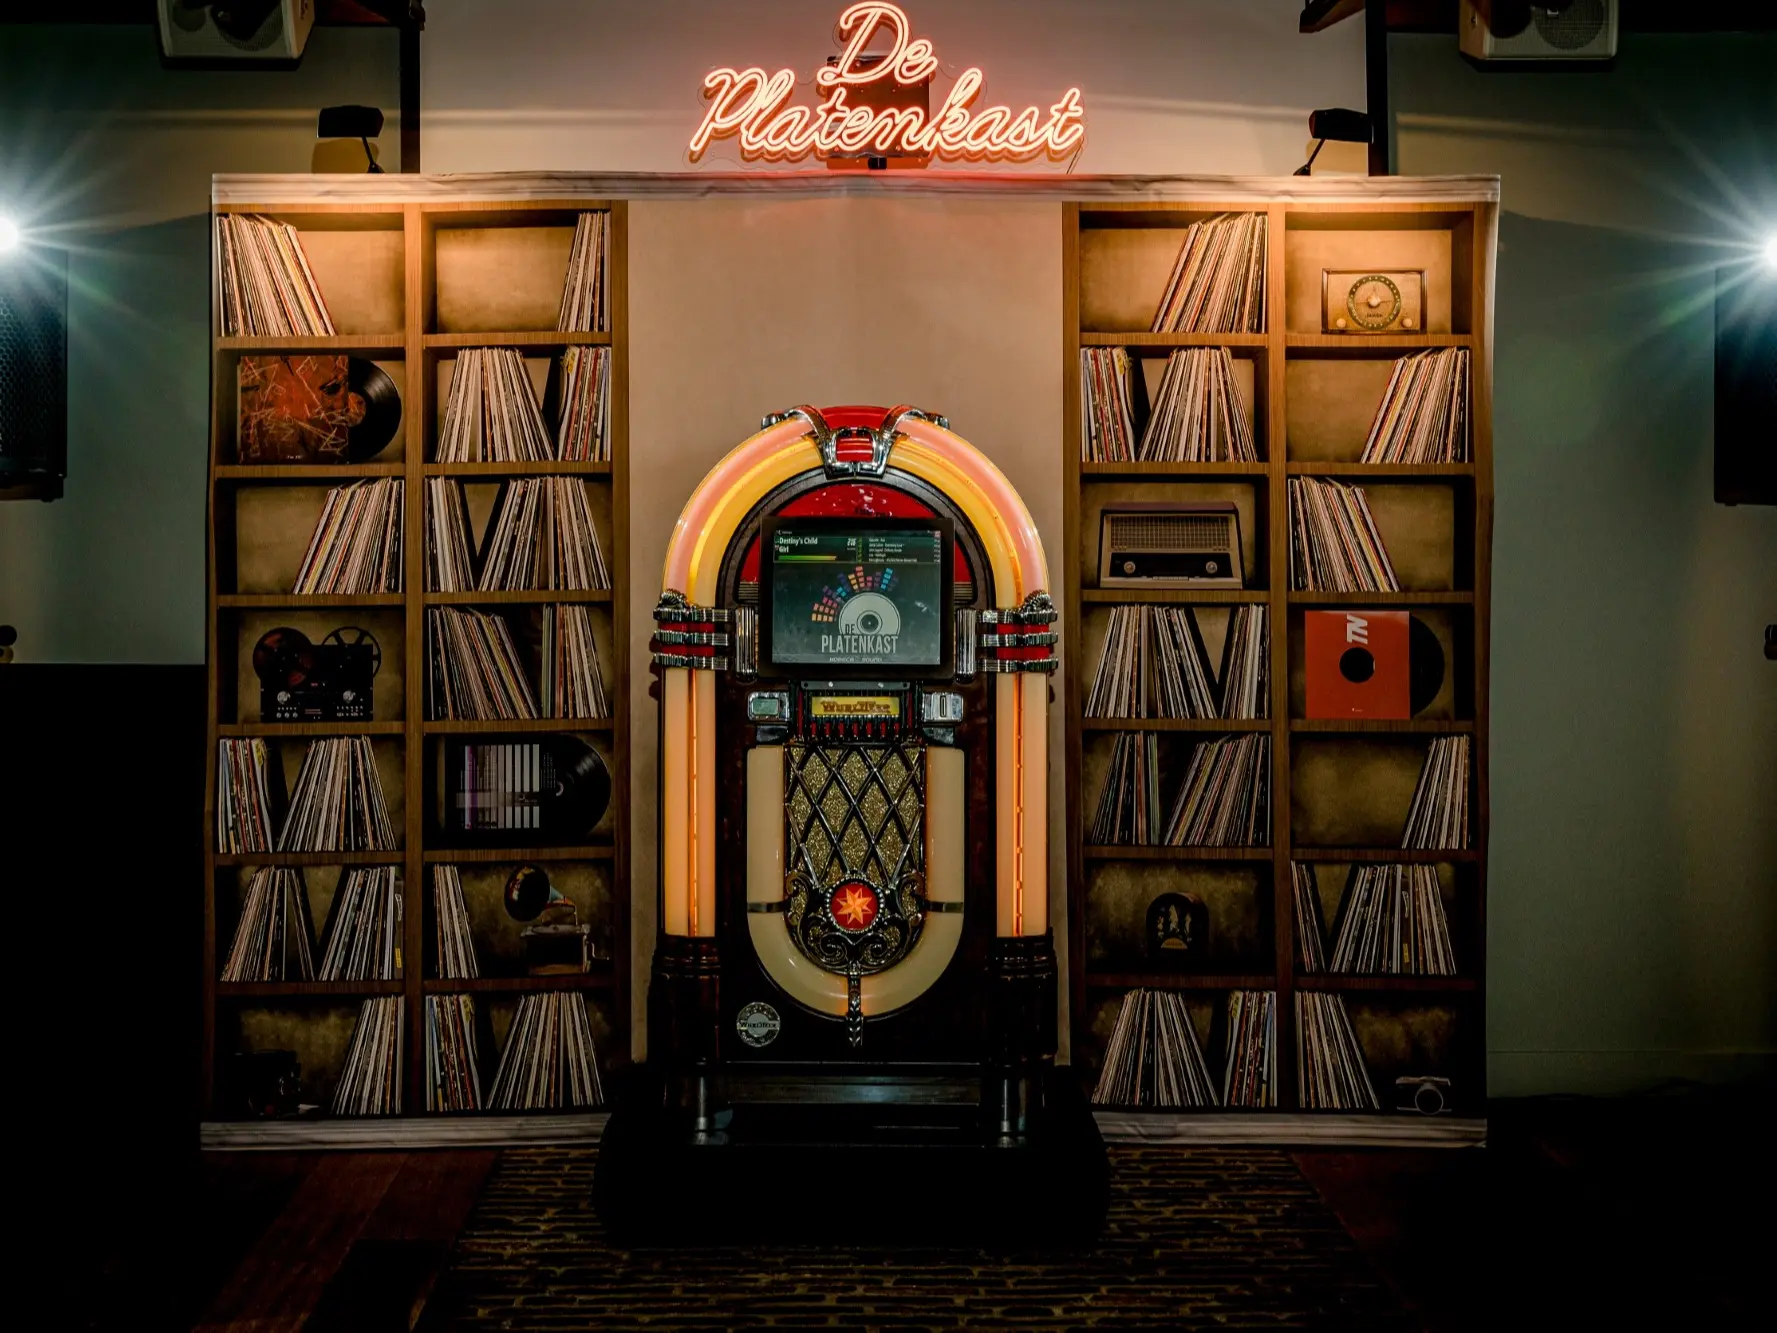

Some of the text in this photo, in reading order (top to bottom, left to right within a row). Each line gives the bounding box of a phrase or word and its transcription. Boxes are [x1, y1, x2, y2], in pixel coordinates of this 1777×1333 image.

[817, 1, 938, 85] De
[689, 68, 1084, 153] Platenkast
[779, 537, 818, 546] Destiny's Child
[845, 623, 856, 634] DE
[821, 634, 899, 654] PLATENKAST
